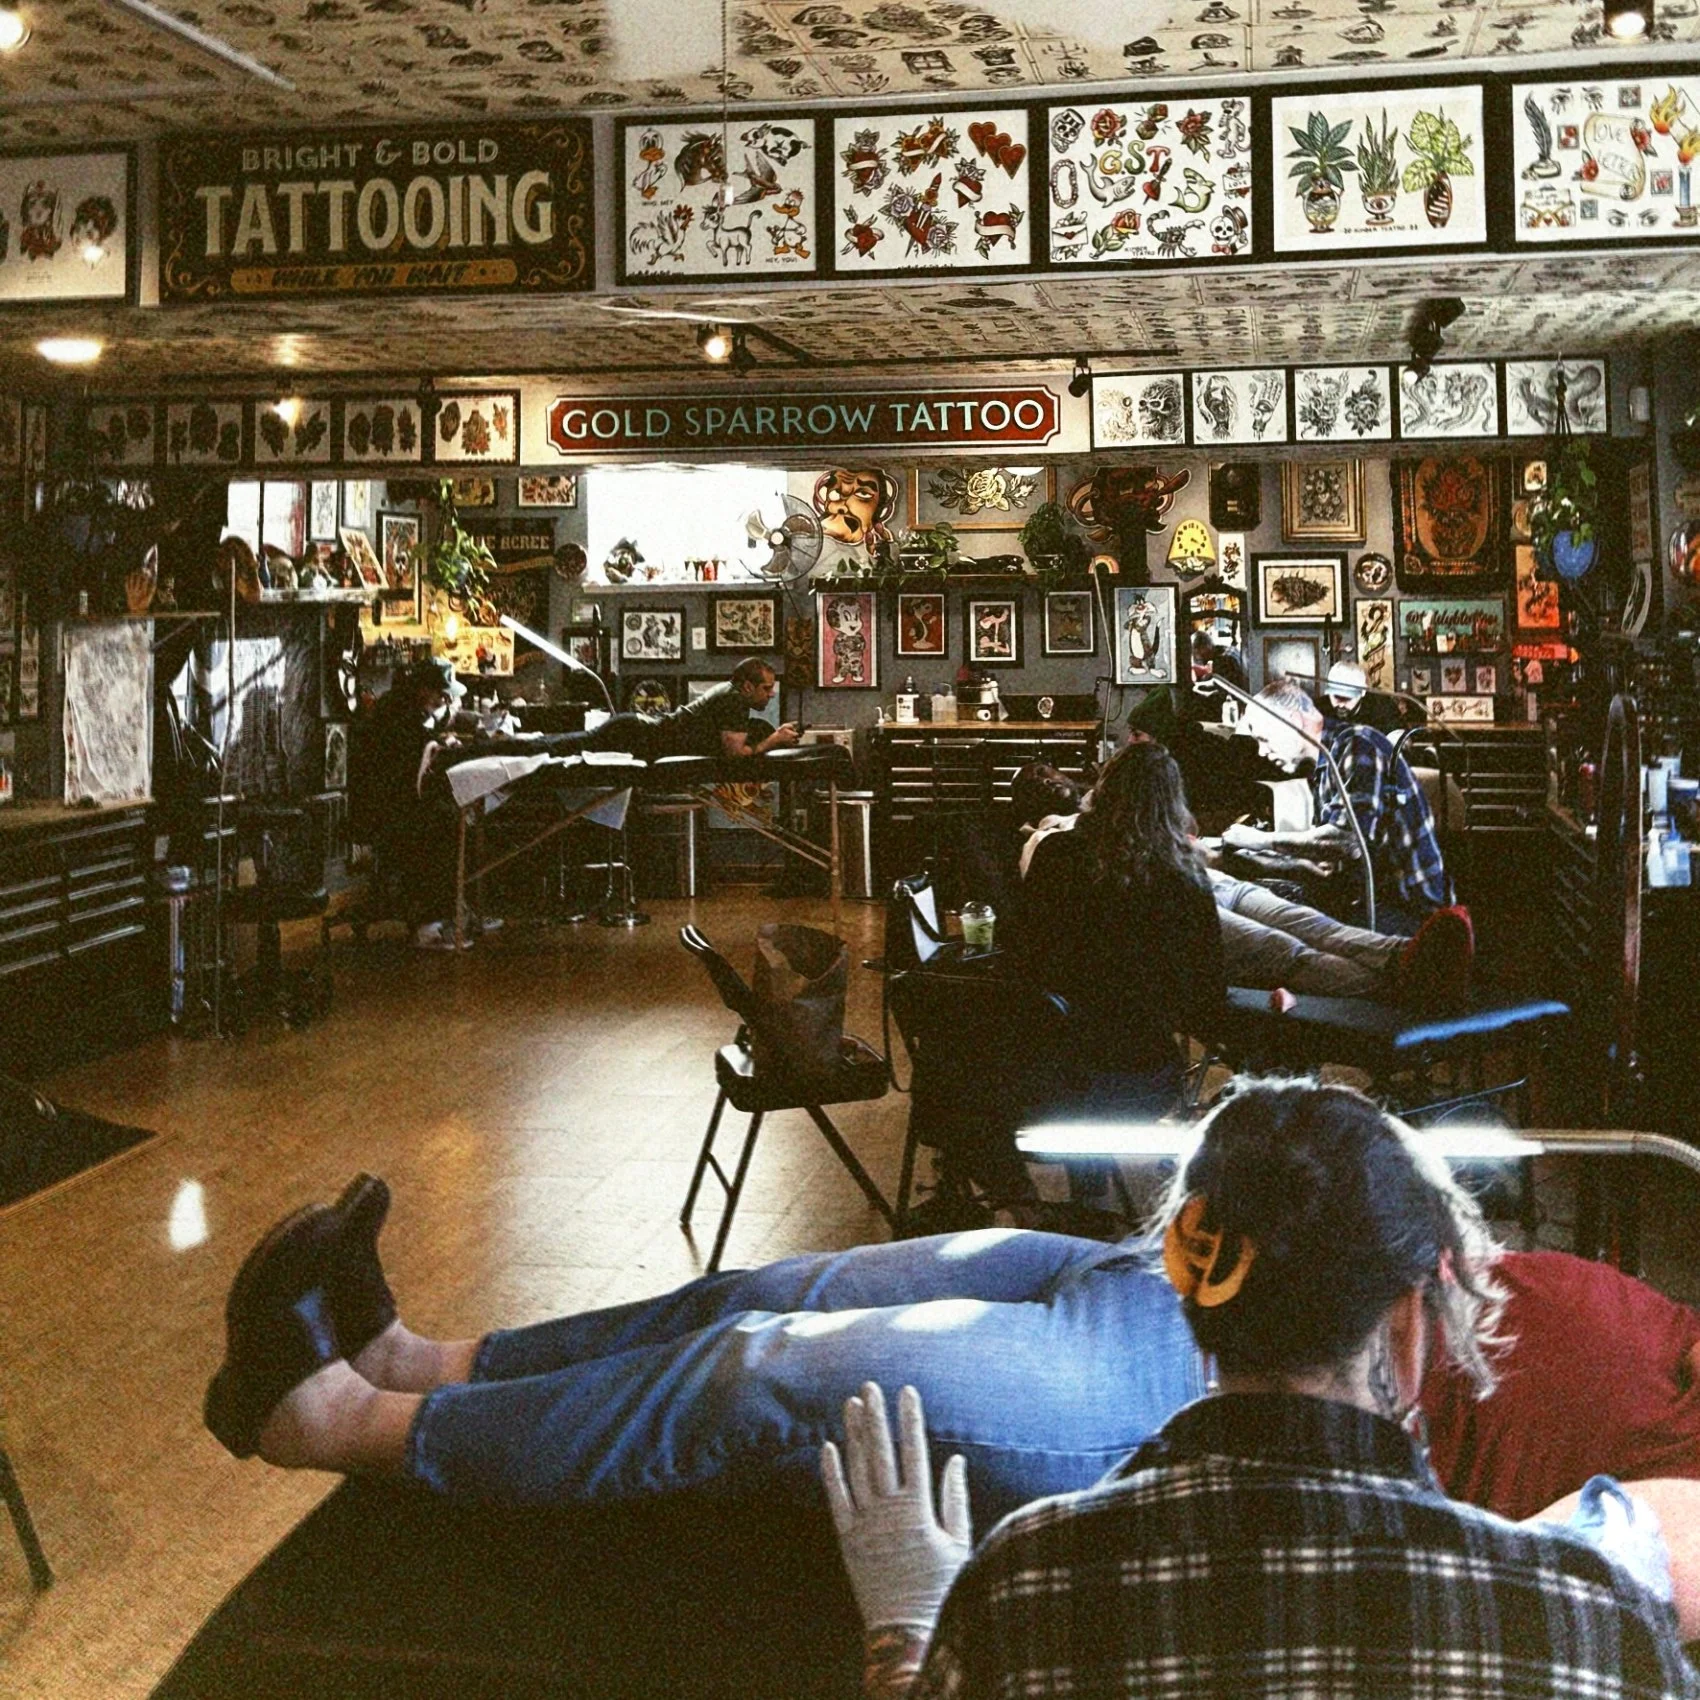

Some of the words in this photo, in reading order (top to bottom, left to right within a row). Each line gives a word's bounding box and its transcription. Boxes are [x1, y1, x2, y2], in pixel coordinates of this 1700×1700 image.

[242, 143, 363, 171] BRIGHT
[375, 139, 401, 165] &
[411, 138, 500, 165] BOLD
[195, 169, 554, 256] TATTOOING
[562, 408, 671, 439] GOLD
[685, 404, 876, 436] SPARROW
[888, 399, 1045, 432] TATTOO
